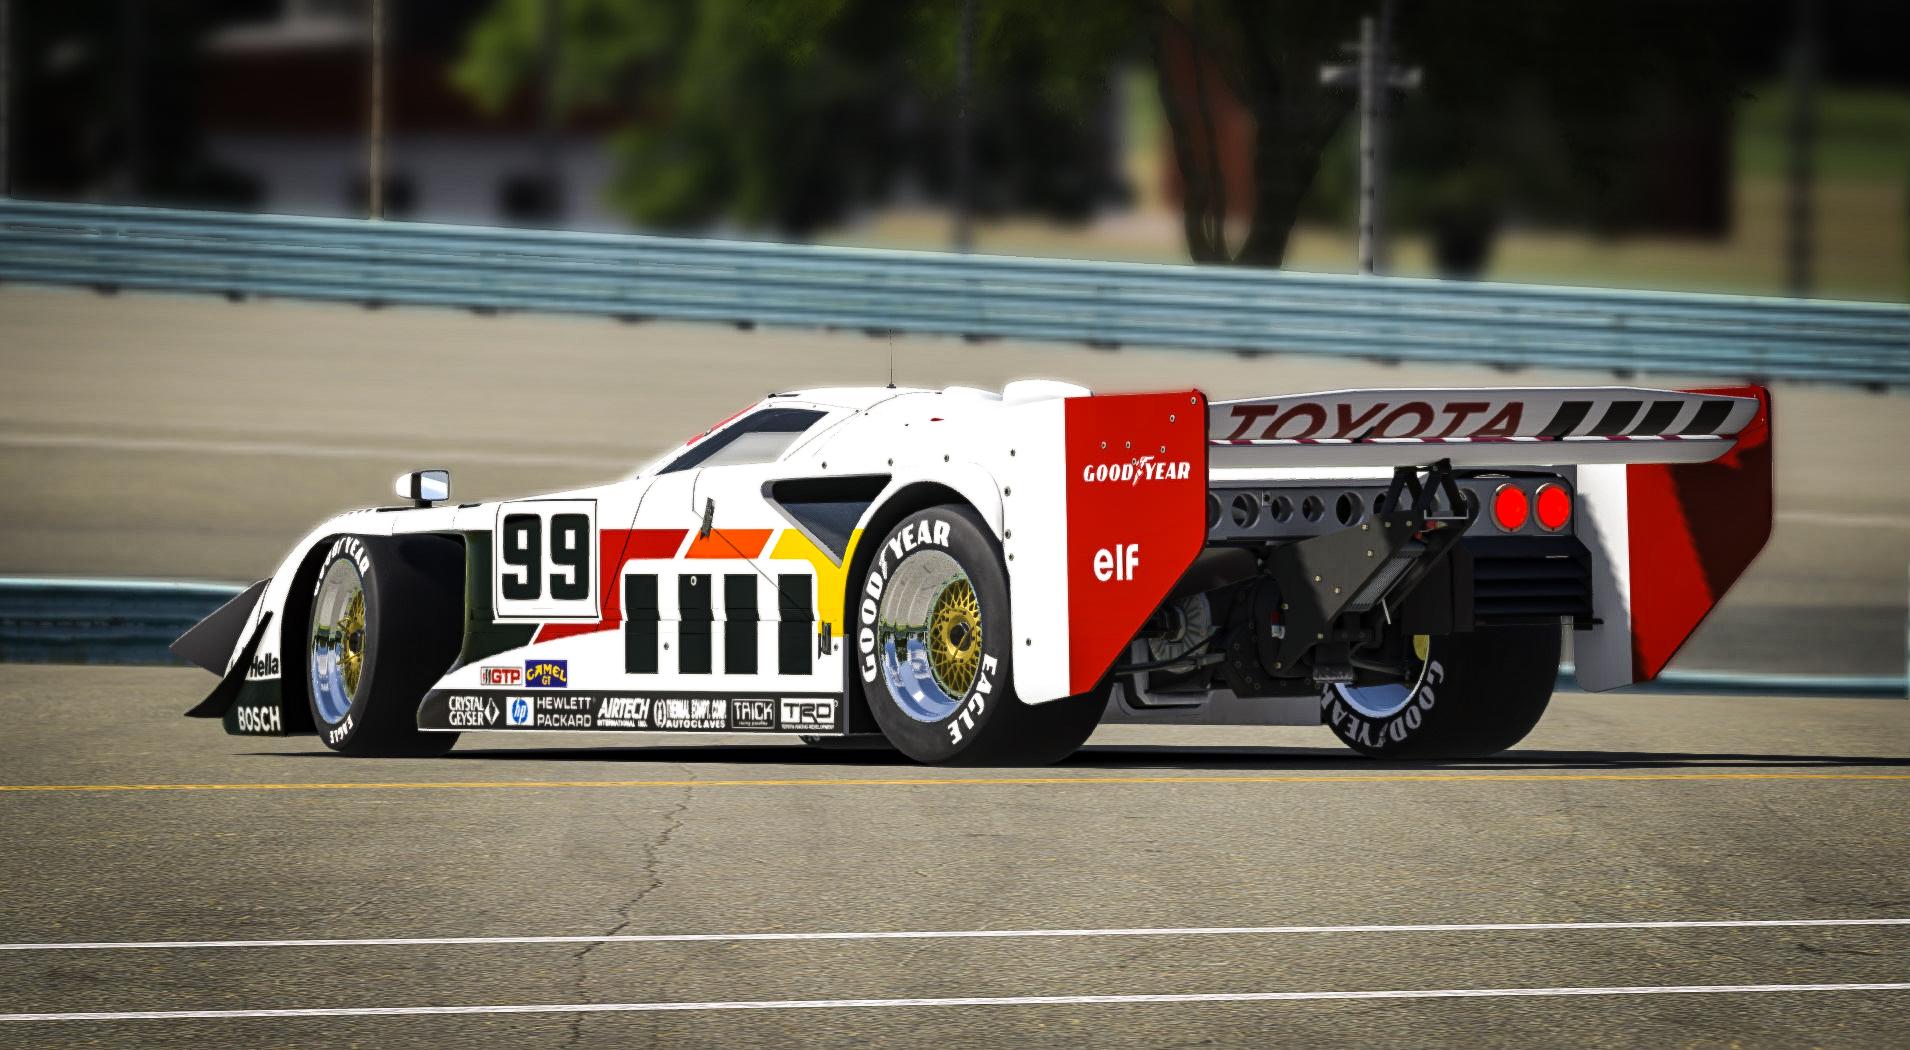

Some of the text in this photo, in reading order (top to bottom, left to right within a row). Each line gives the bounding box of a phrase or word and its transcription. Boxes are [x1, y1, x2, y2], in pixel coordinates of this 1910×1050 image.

[1226, 402, 1524, 439] TOYOTA
[502, 513, 590, 600] 99
[1093, 543, 1140, 581] elf
[249, 652, 279, 678] Hella
[526, 663, 567, 682] CAMEL
[491, 669, 521, 684] GTP
[449, 696, 484, 710] CRYSTAL
[537, 697, 591, 709] HEWLETT
[598, 697, 651, 719] AIRTECH
[947, 653, 998, 745] EAGLE
[237, 706, 281, 732] BOSCH
[449, 711, 484, 726] GEYSER
[537, 714, 592, 728] PACKARD
[734, 702, 773, 721] TRICK
[783, 703, 832, 723] TRD
[329, 714, 354, 744] EAGLE
[666, 719, 726, 729] AUTOCLAVES
